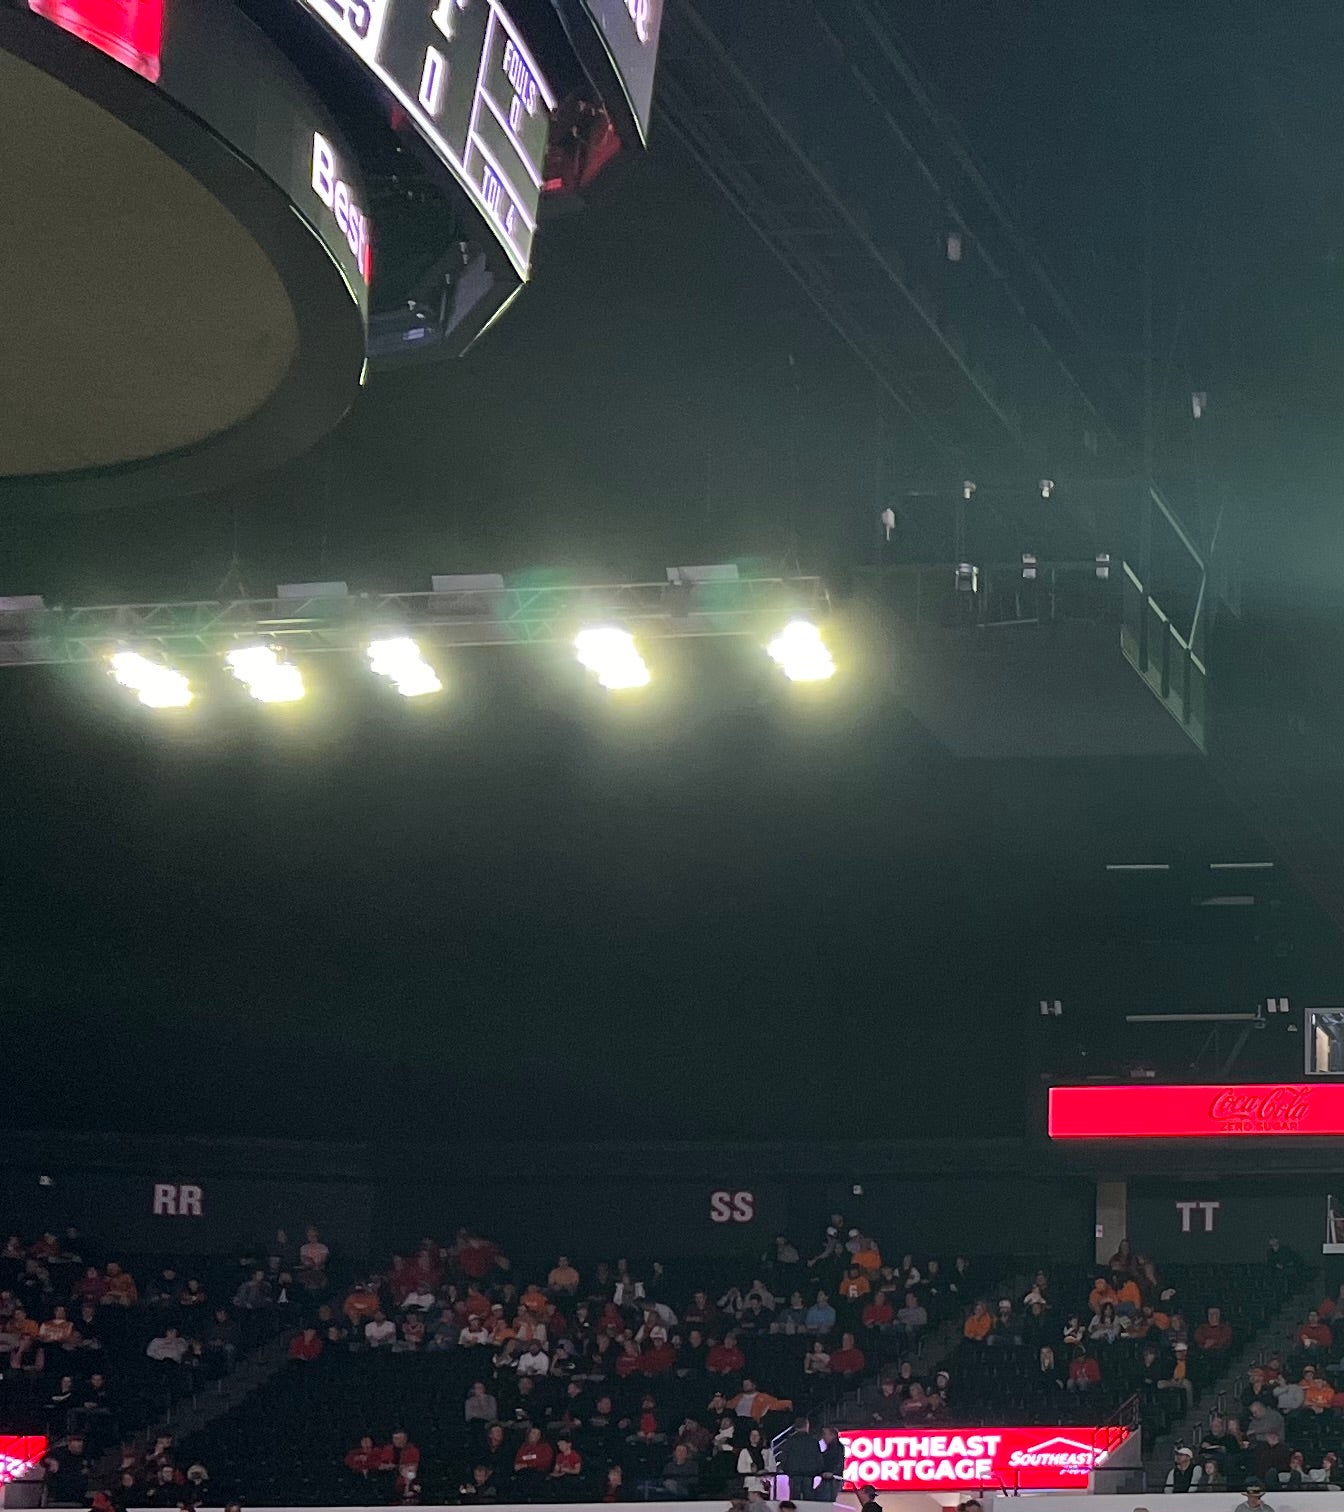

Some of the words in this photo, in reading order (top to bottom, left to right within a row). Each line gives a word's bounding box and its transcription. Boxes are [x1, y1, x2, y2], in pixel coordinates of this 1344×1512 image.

[1219, 1121, 1254, 1132] ZERO
[1256, 1120, 1299, 1131] SUGAR
[153, 1184, 203, 1216] RR
[711, 1192, 754, 1222] SS
[1176, 1202, 1221, 1231] TT
[839, 1435, 1001, 1459] SOUTHEAST
[843, 1458, 993, 1482] MORTGAGE
